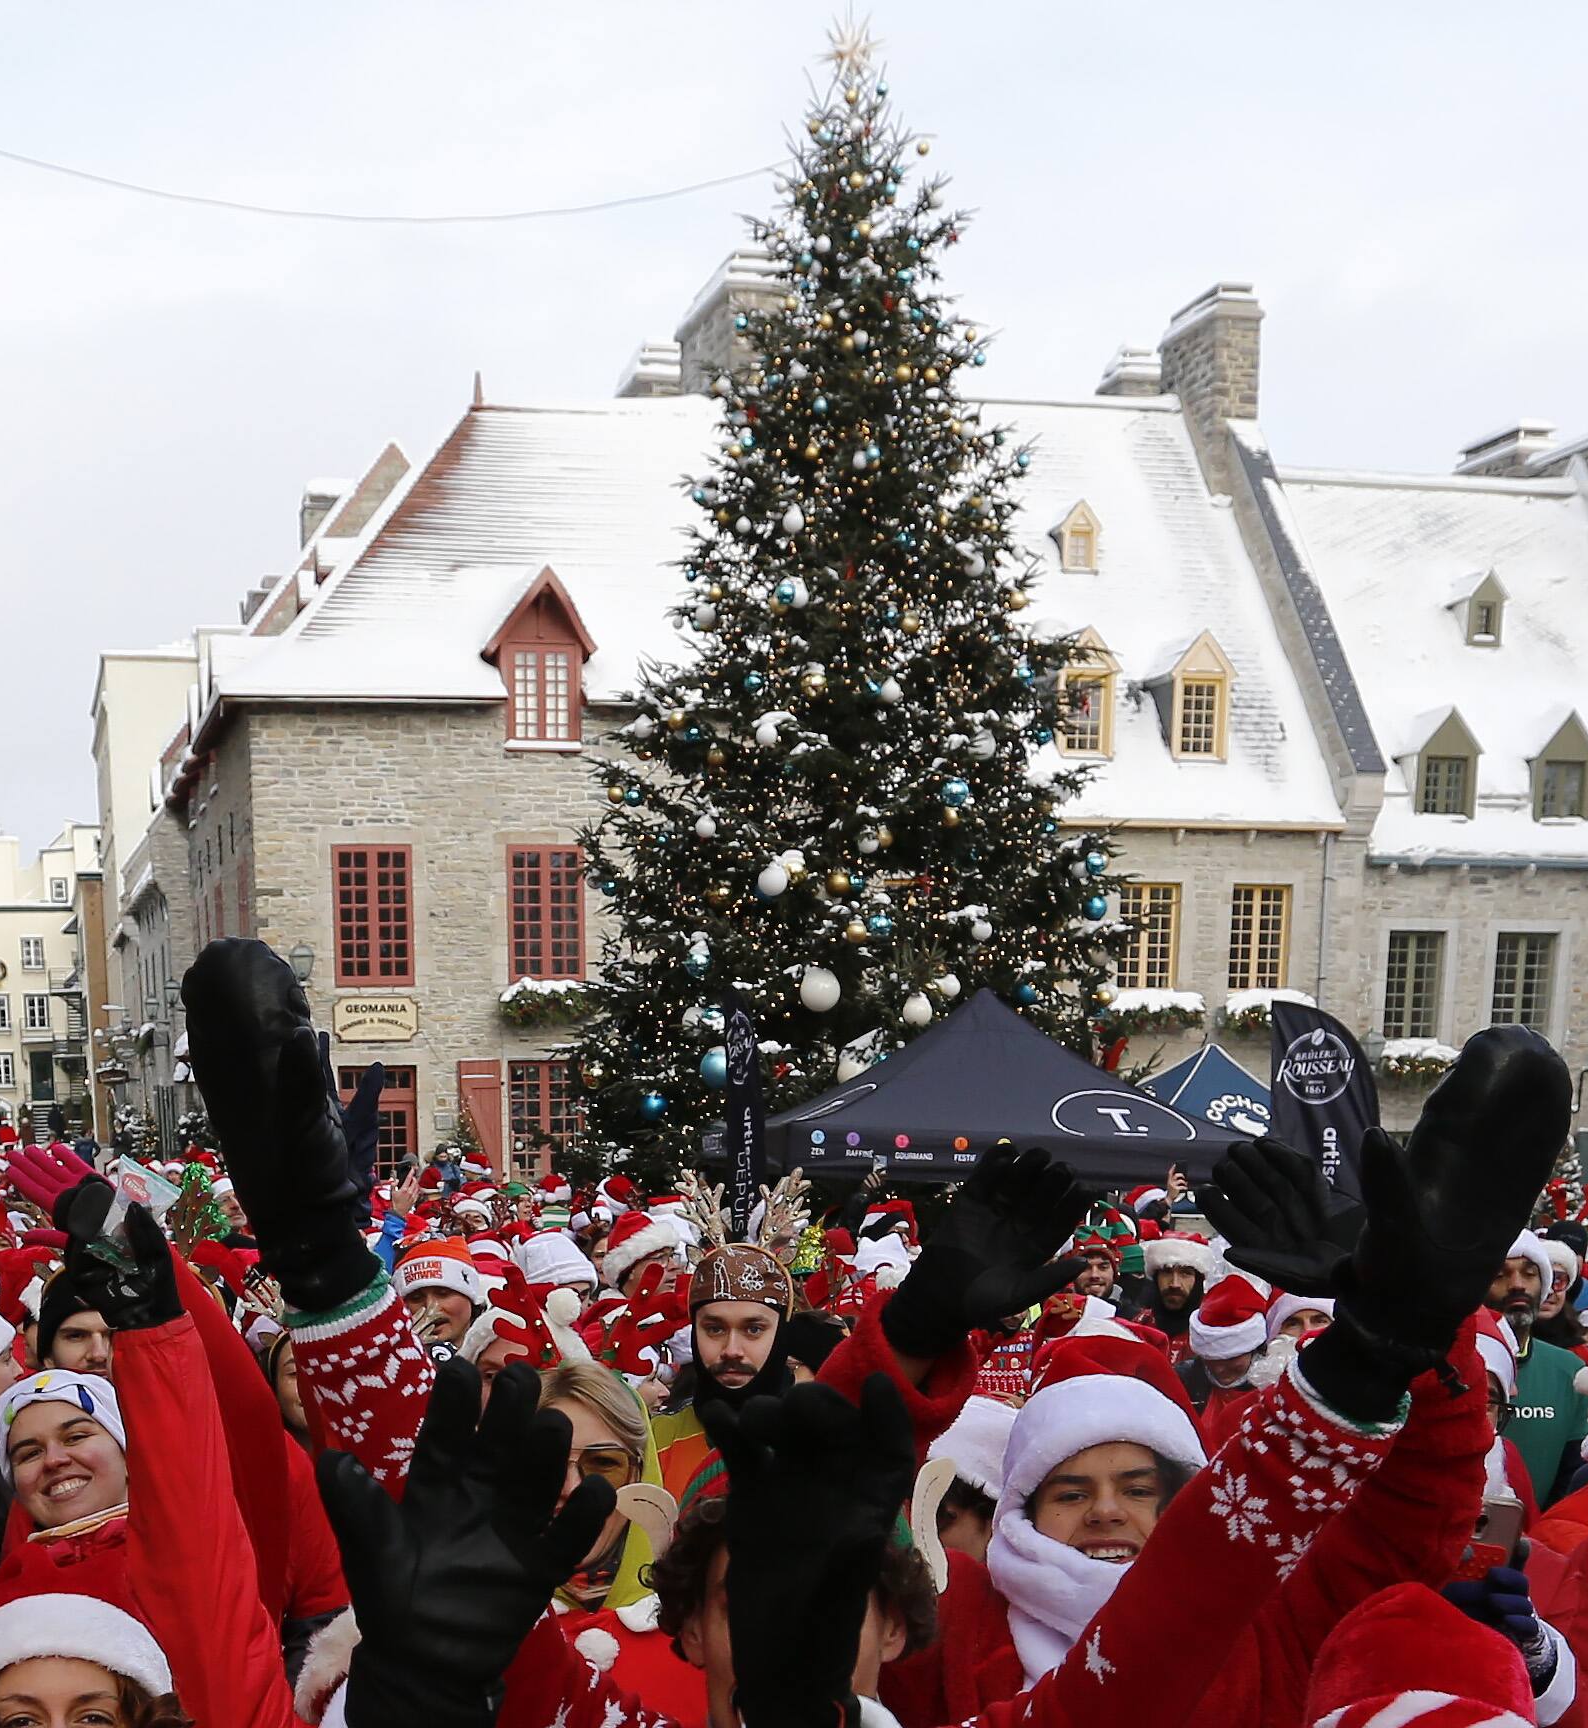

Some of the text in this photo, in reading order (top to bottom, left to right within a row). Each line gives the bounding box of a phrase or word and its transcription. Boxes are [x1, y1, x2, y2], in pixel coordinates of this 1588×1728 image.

[345, 1004, 408, 1014] GEOMANIA
[1276, 1058, 1356, 1083] ROUSSEAU
[810, 1147, 825, 1155] ZEN
[895, 1151, 934, 1160] GOURMAND
